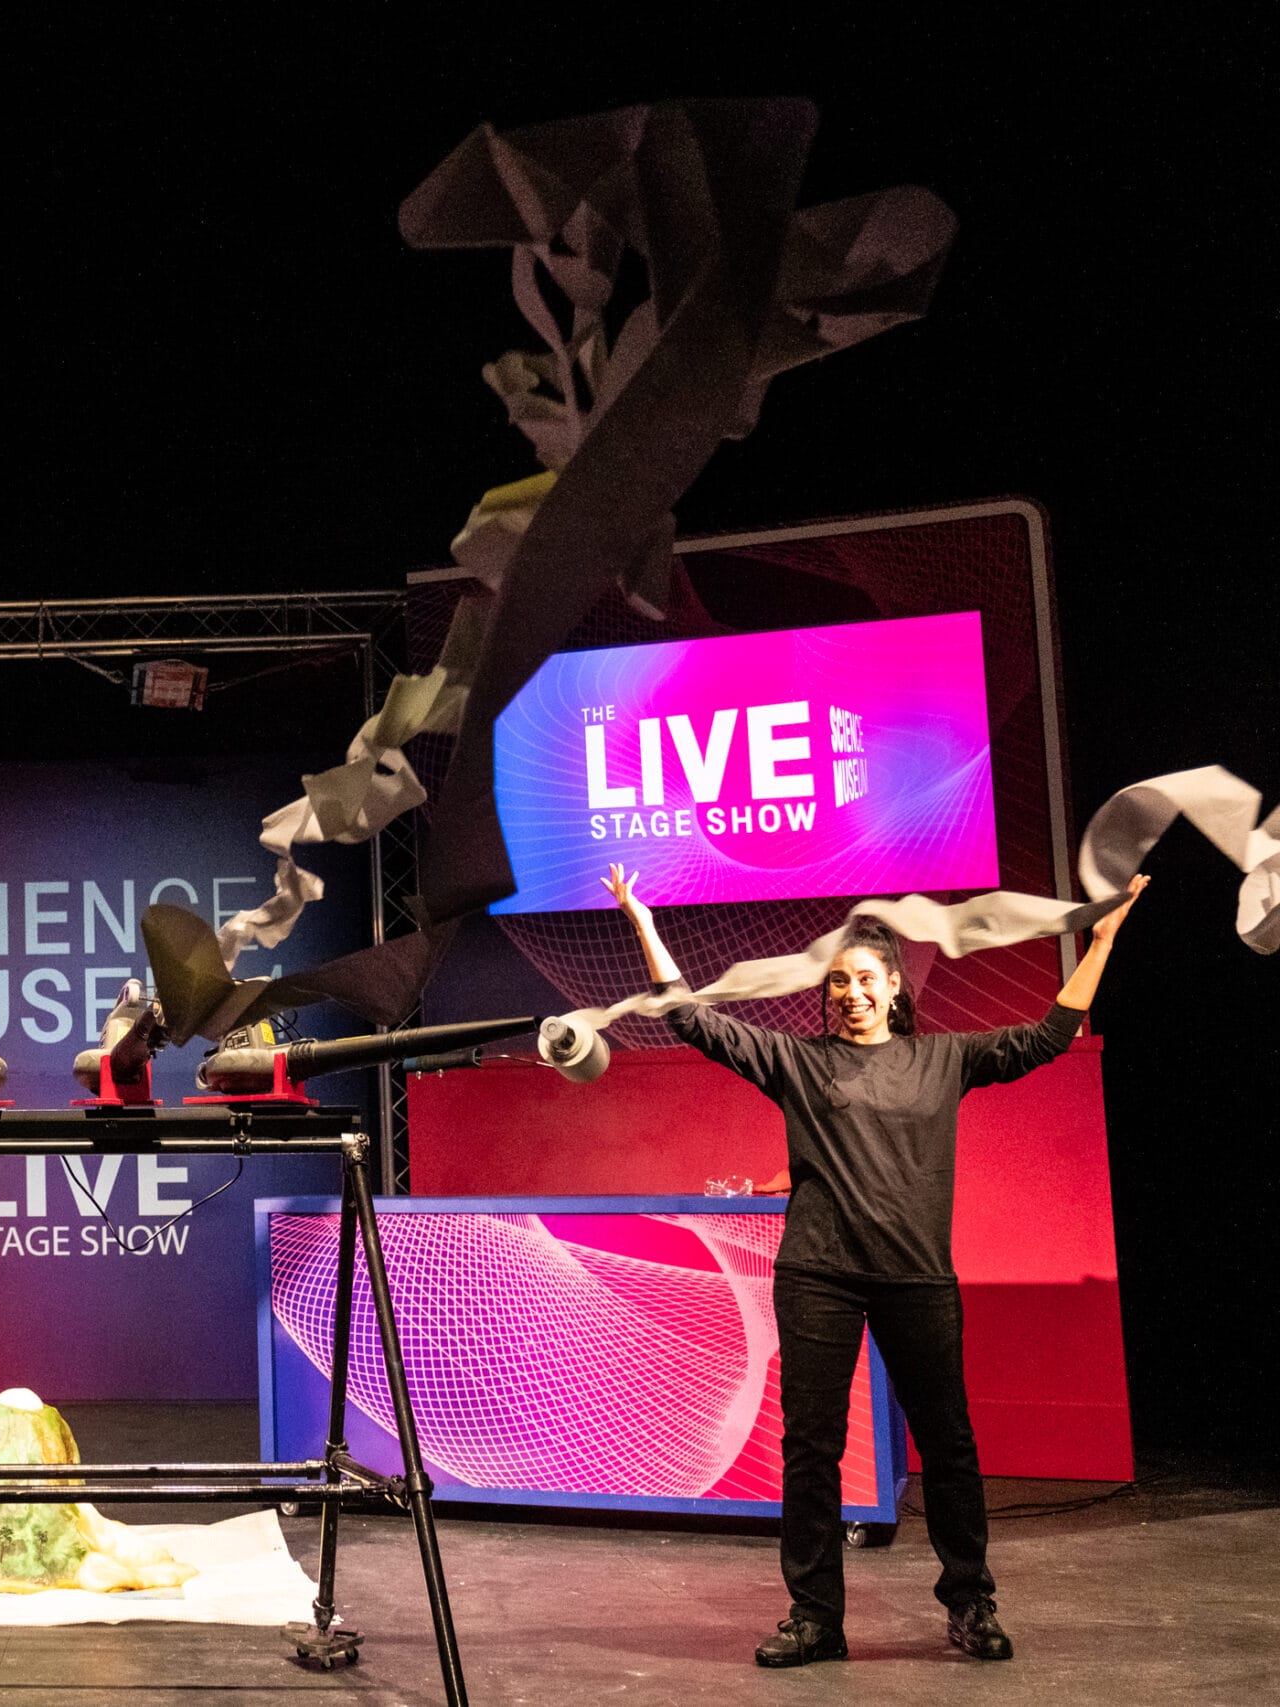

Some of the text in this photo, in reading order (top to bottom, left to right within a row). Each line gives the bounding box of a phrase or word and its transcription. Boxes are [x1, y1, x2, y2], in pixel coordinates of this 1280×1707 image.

[581, 704, 616, 723] THE
[829, 705, 864, 753] SCIENCE
[584, 700, 815, 809] LIVE
[590, 802, 817, 840] STAGE SHOW
[80, 1225, 190, 1257] SHOW
